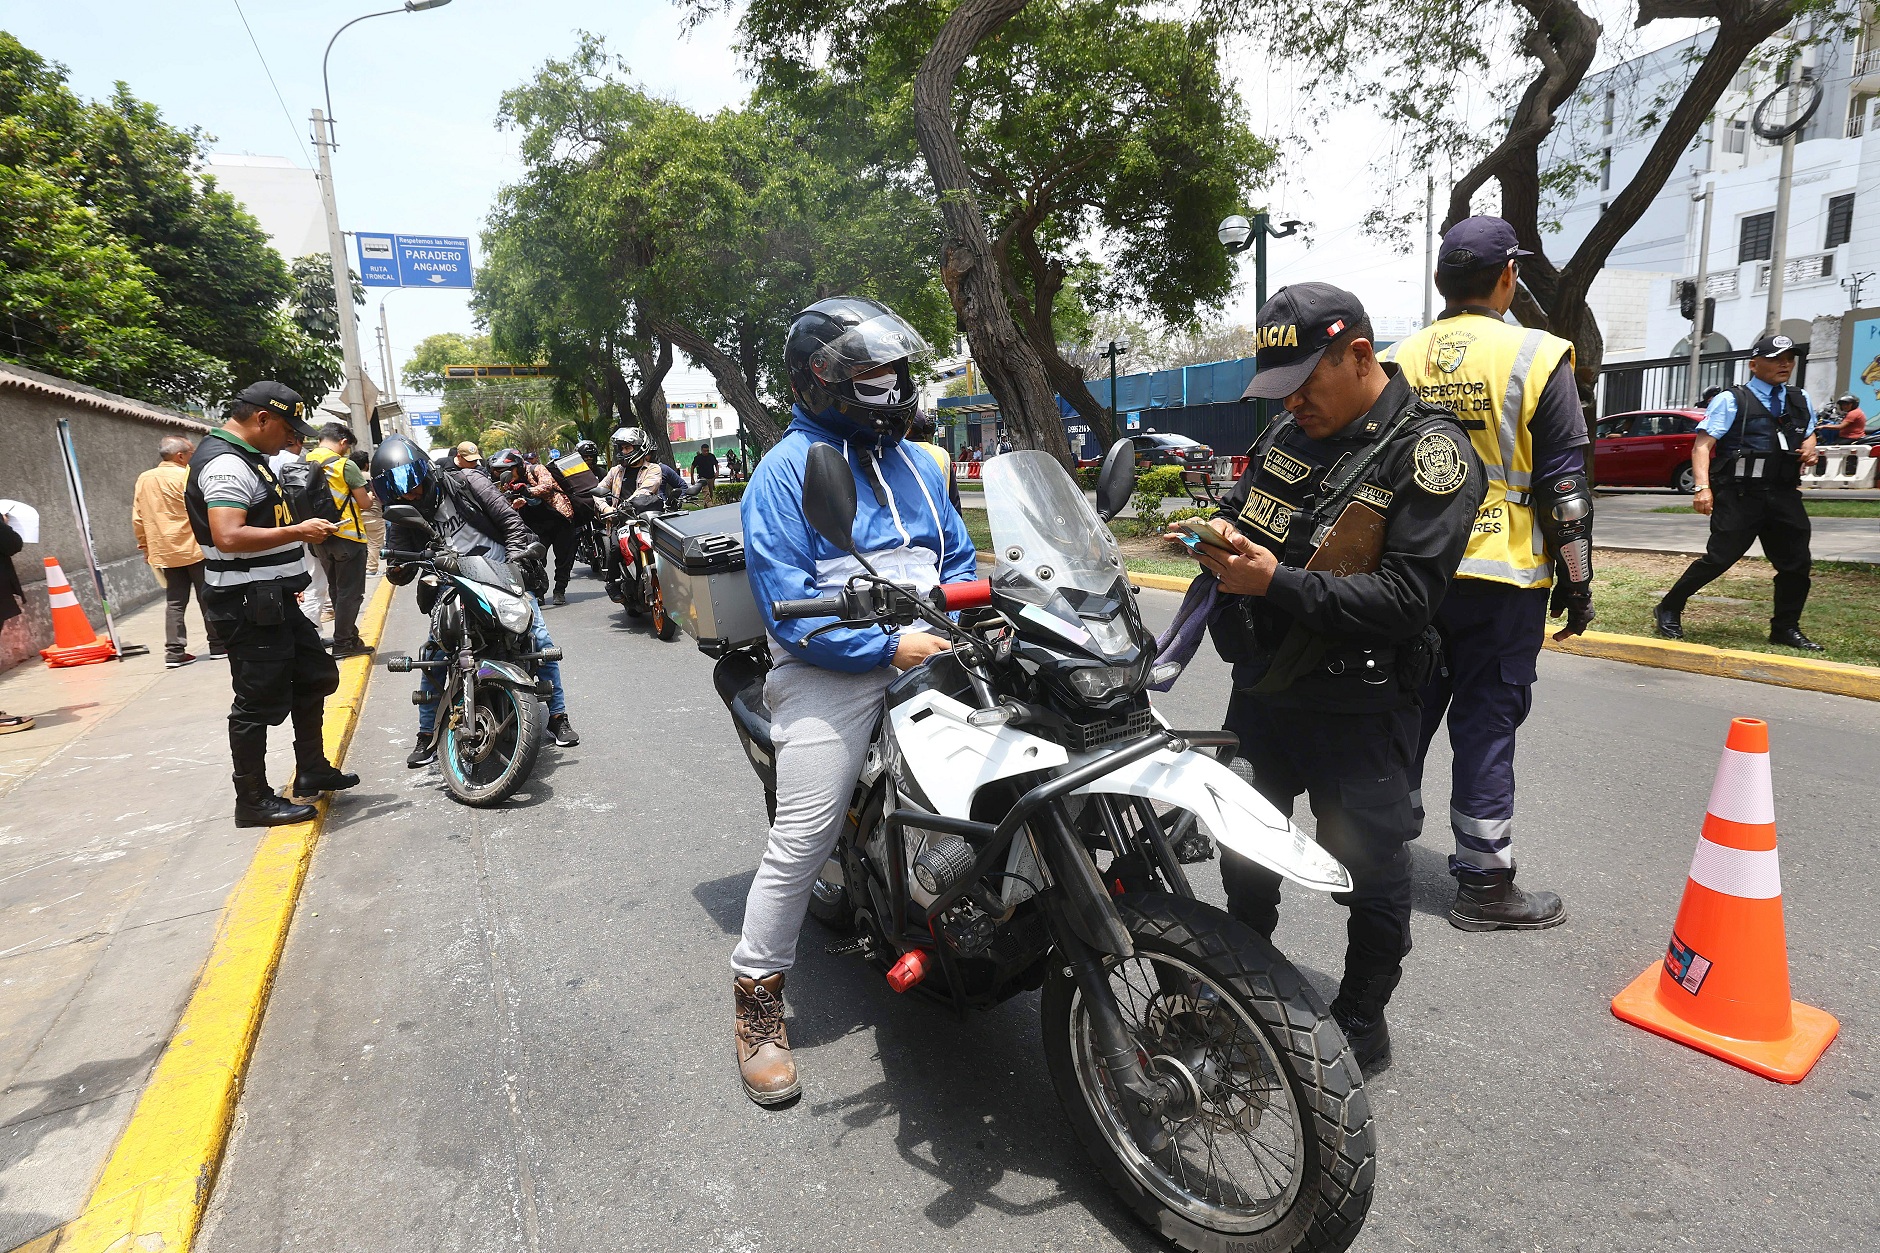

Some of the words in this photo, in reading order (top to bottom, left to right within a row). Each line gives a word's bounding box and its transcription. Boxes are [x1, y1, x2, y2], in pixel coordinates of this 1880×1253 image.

[399, 237, 434, 245] Respetemos
[405, 250, 461, 261] PARADERO
[413, 262, 458, 272] ANGAMOS
[1256, 325, 1298, 349] LICIA
[1436, 330, 1477, 344] MIRAFLORES
[1410, 382, 1484, 397] NSPECTOR
[1473, 398, 1492, 411] DE
[1242, 491, 1277, 527] POLICIA
